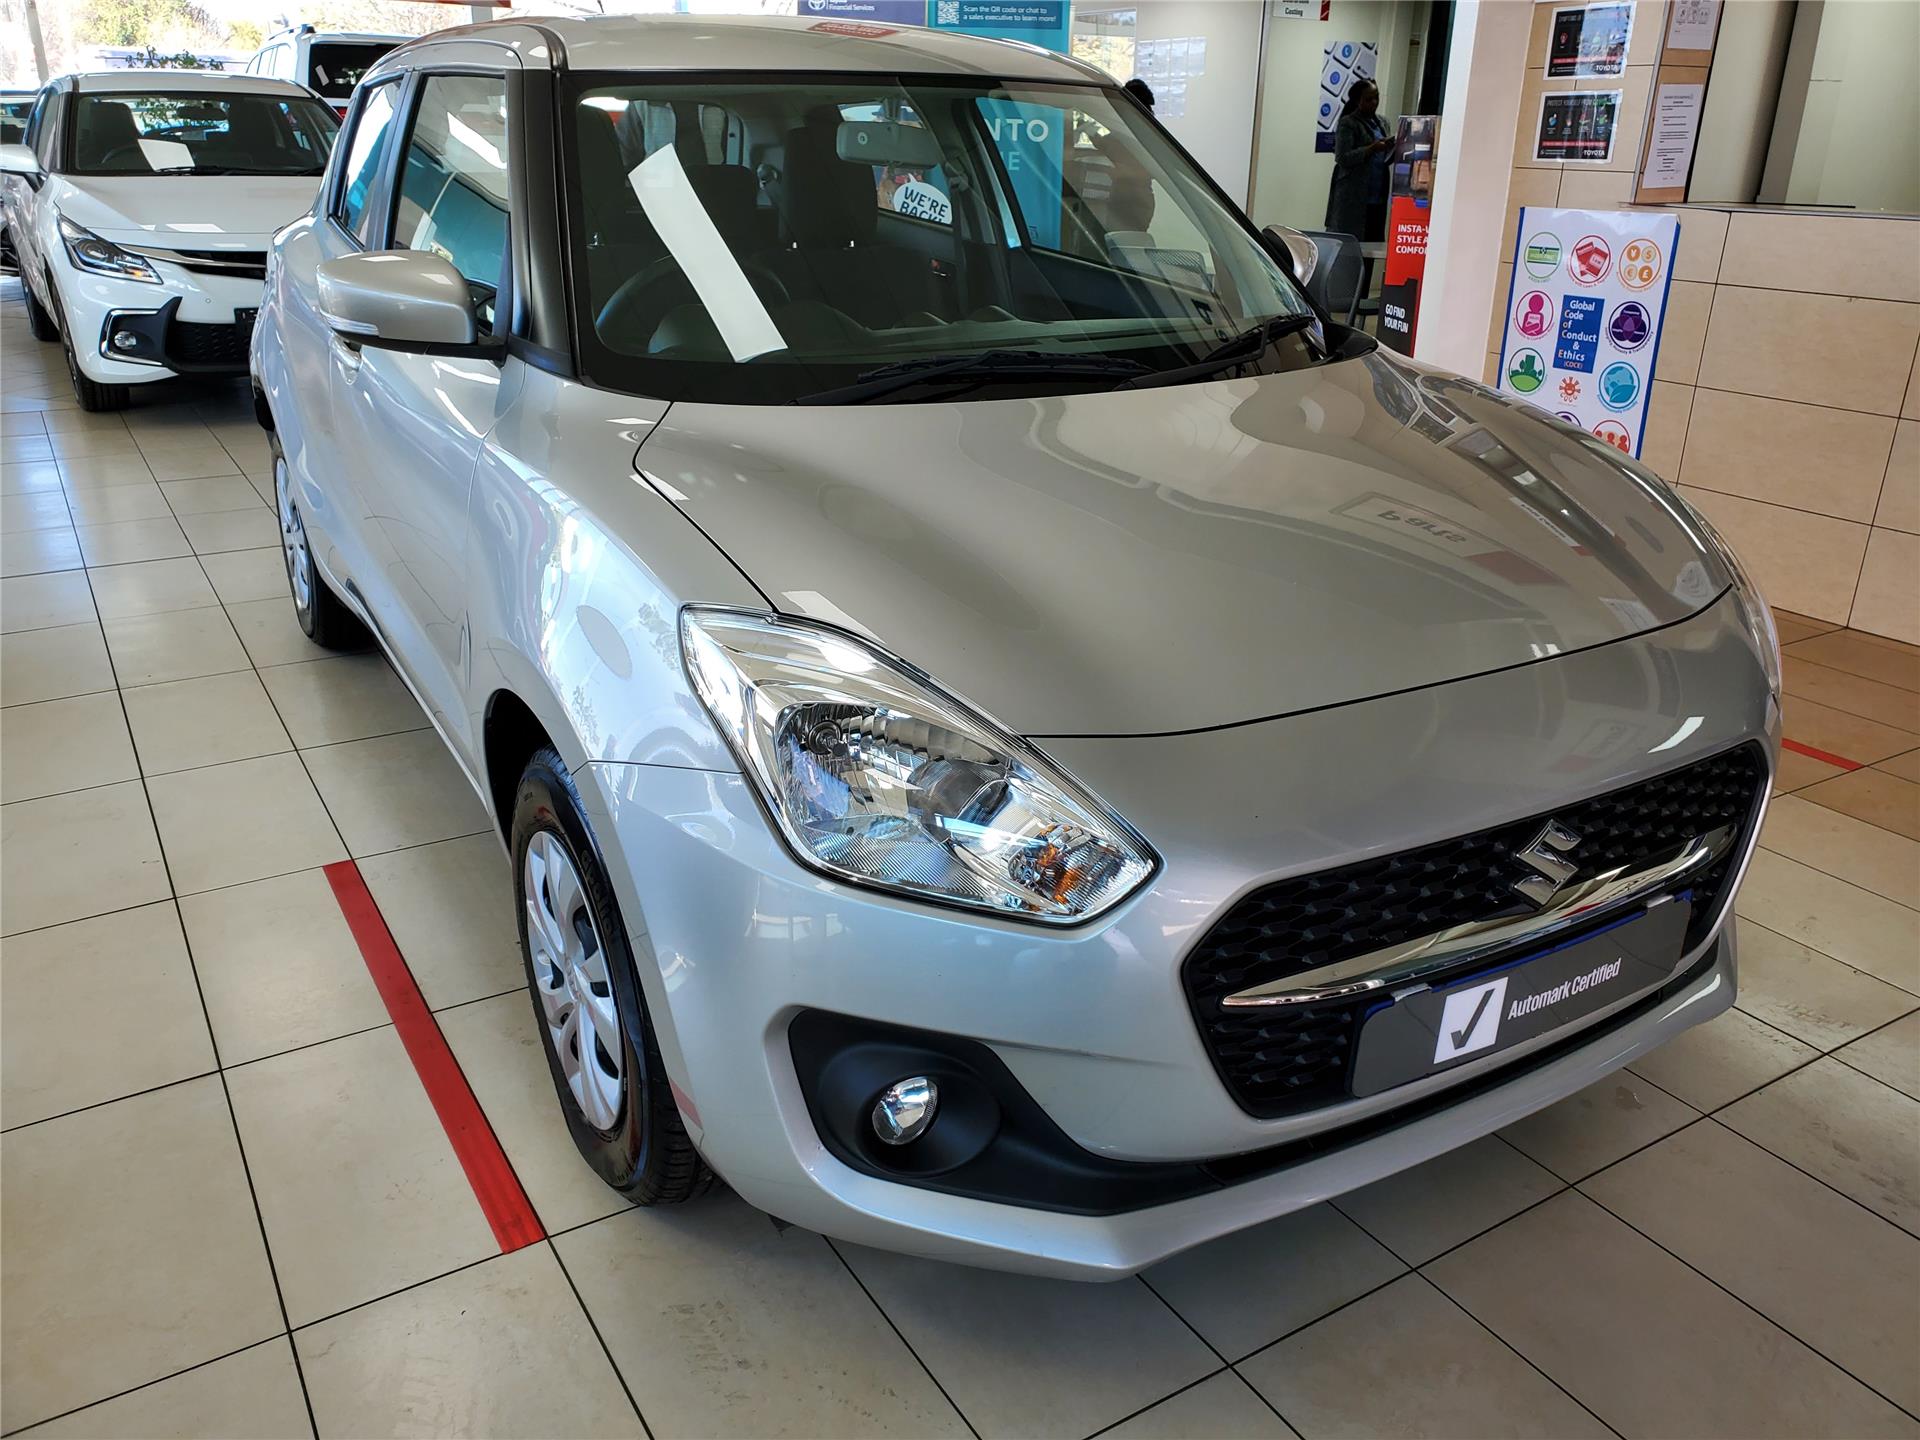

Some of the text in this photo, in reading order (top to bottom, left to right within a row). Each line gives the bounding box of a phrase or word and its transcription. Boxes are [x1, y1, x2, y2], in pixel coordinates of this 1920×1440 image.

[904, 186, 949, 218] WE'RE
[1396, 235, 1423, 244] STYLE
[1395, 245, 1427, 255] COMFO
[1385, 303, 1406, 319] GO FIND
[1569, 299, 1596, 311] Global
[1564, 310, 1584, 321] Code
[1384, 315, 1409, 334] YOUR FUN
[1562, 320, 1572, 329] of
[1561, 330, 1597, 343] Conduct
[1572, 341, 1580, 350] &
[1557, 349, 1585, 362] Ethics
[1507, 956, 1622, 1021] Automark Certified
